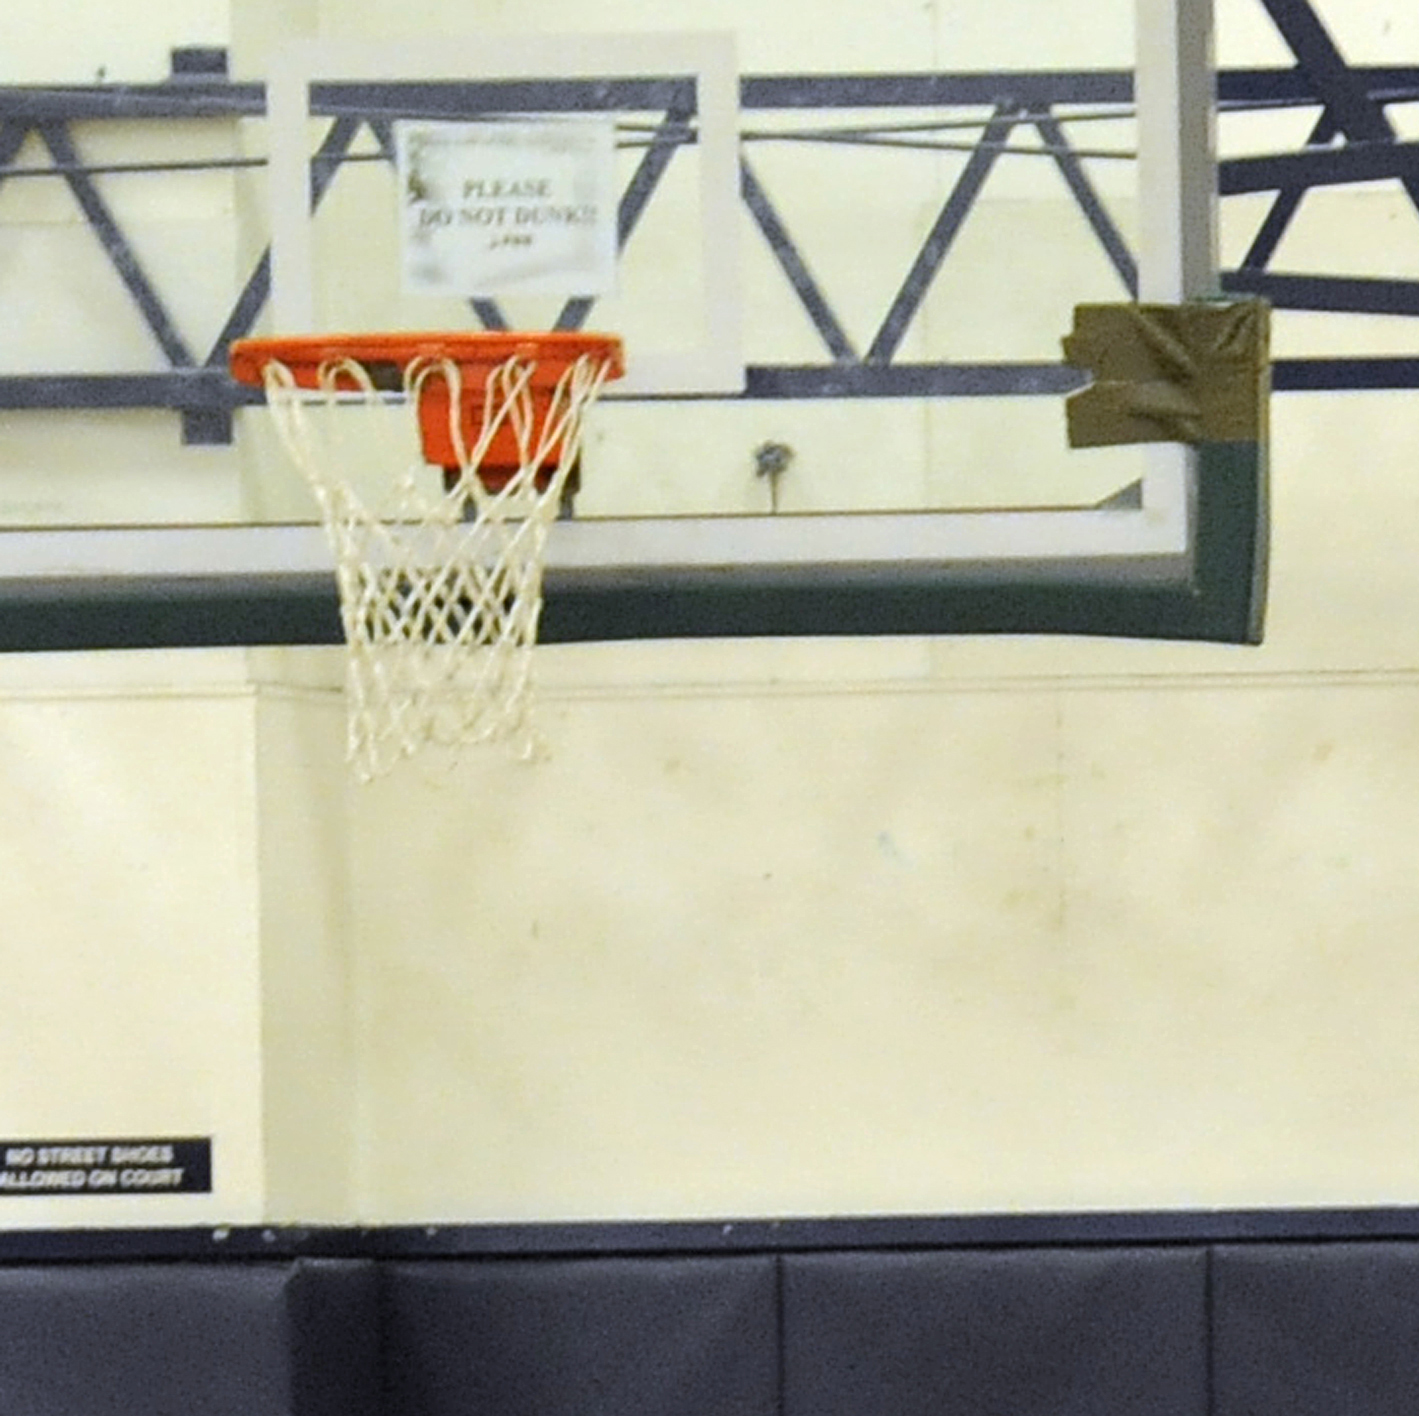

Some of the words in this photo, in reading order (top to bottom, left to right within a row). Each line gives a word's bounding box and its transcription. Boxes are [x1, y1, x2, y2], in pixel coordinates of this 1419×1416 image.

[462, 178, 552, 200] PLEASE
[418, 206, 452, 226] DO
[460, 206, 506, 226] NOT
[6, 1147, 35, 1167] NO
[37, 1146, 108, 1166] STREET
[88, 1169, 118, 1187] ON
[120, 1168, 185, 1186] COURT
